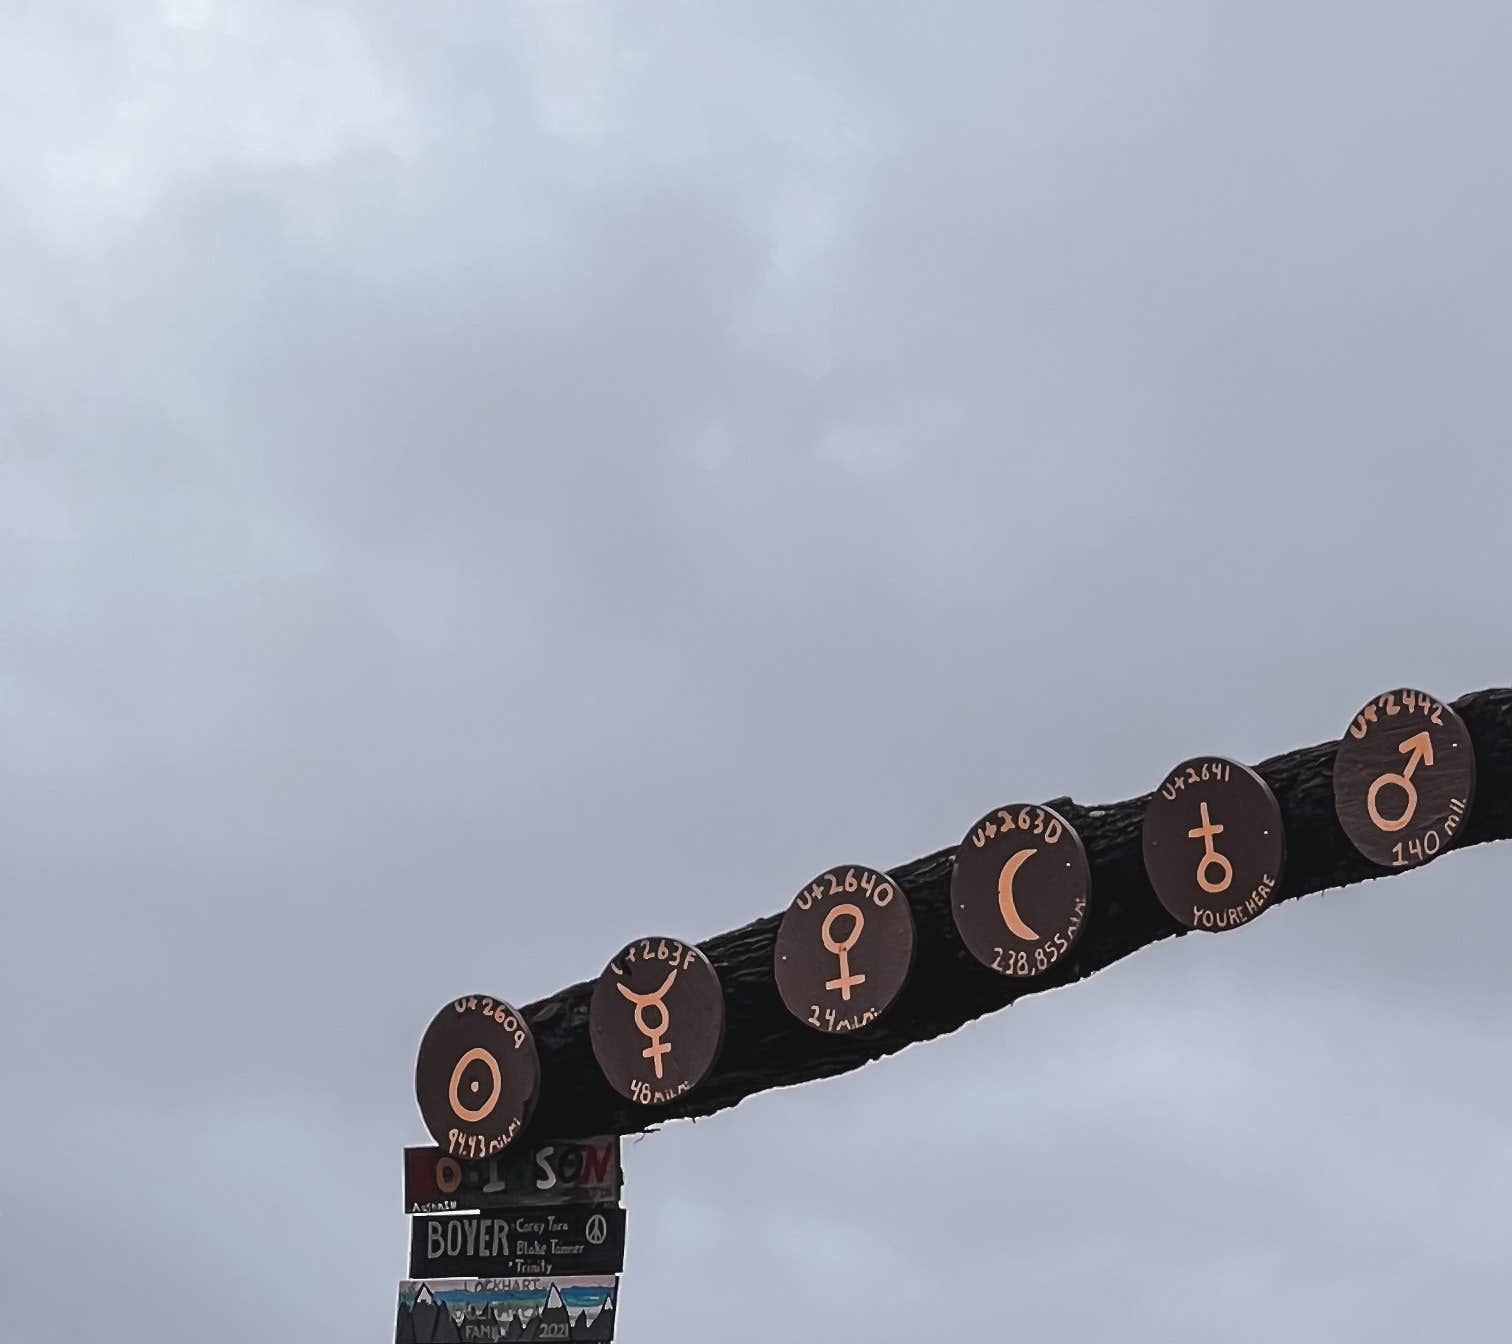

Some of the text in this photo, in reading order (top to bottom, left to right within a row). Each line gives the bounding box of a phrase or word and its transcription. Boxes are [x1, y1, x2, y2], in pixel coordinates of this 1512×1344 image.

[1391, 830, 1440, 867] 140
[807, 1004, 836, 1031] 24
[630, 1079, 652, 1105] 48
[427, 1219, 509, 1259] BOYER
